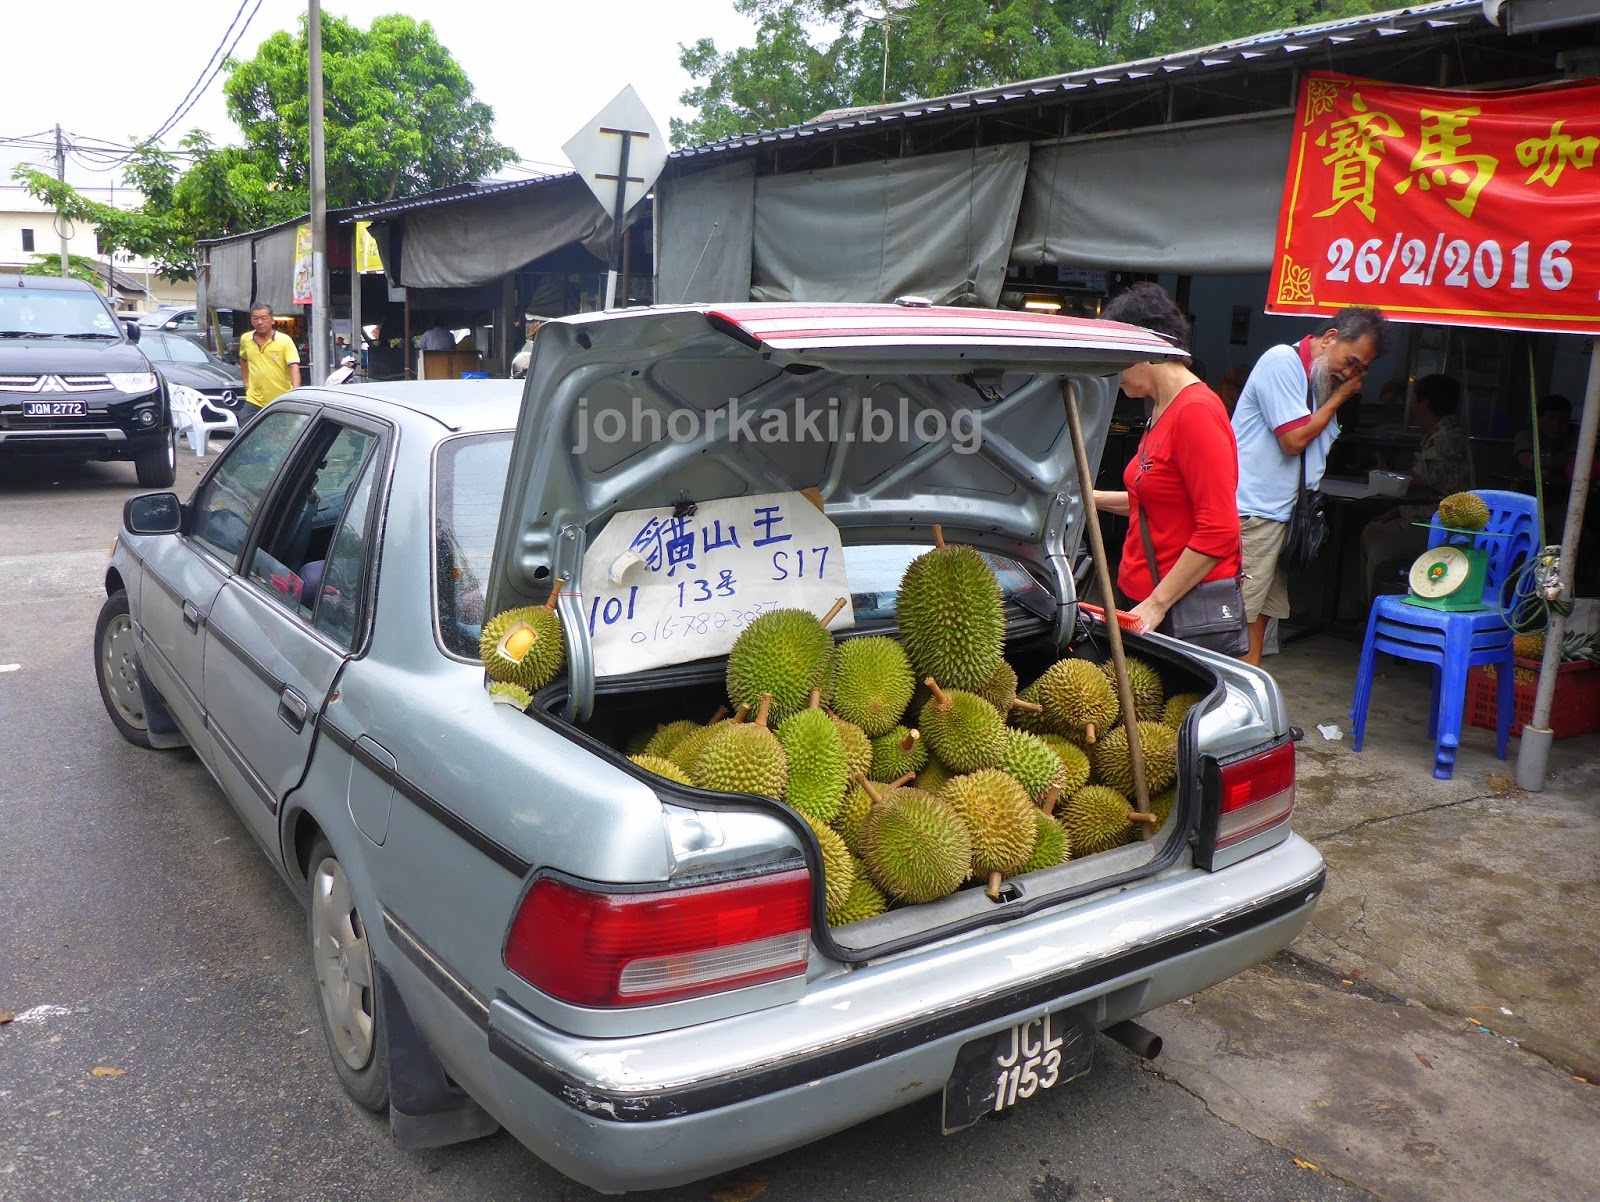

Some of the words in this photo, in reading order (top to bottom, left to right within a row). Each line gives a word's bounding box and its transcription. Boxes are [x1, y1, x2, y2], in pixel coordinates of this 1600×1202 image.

[1325, 232, 1574, 291] 26/2/2016
[28, 403, 51, 415] JQM
[53, 403, 82, 415] 2772
[771, 546, 829, 581] S17
[589, 586, 639, 638] 101
[997, 1013, 1064, 1067] JCL
[995, 1049, 1062, 1111] 1153
